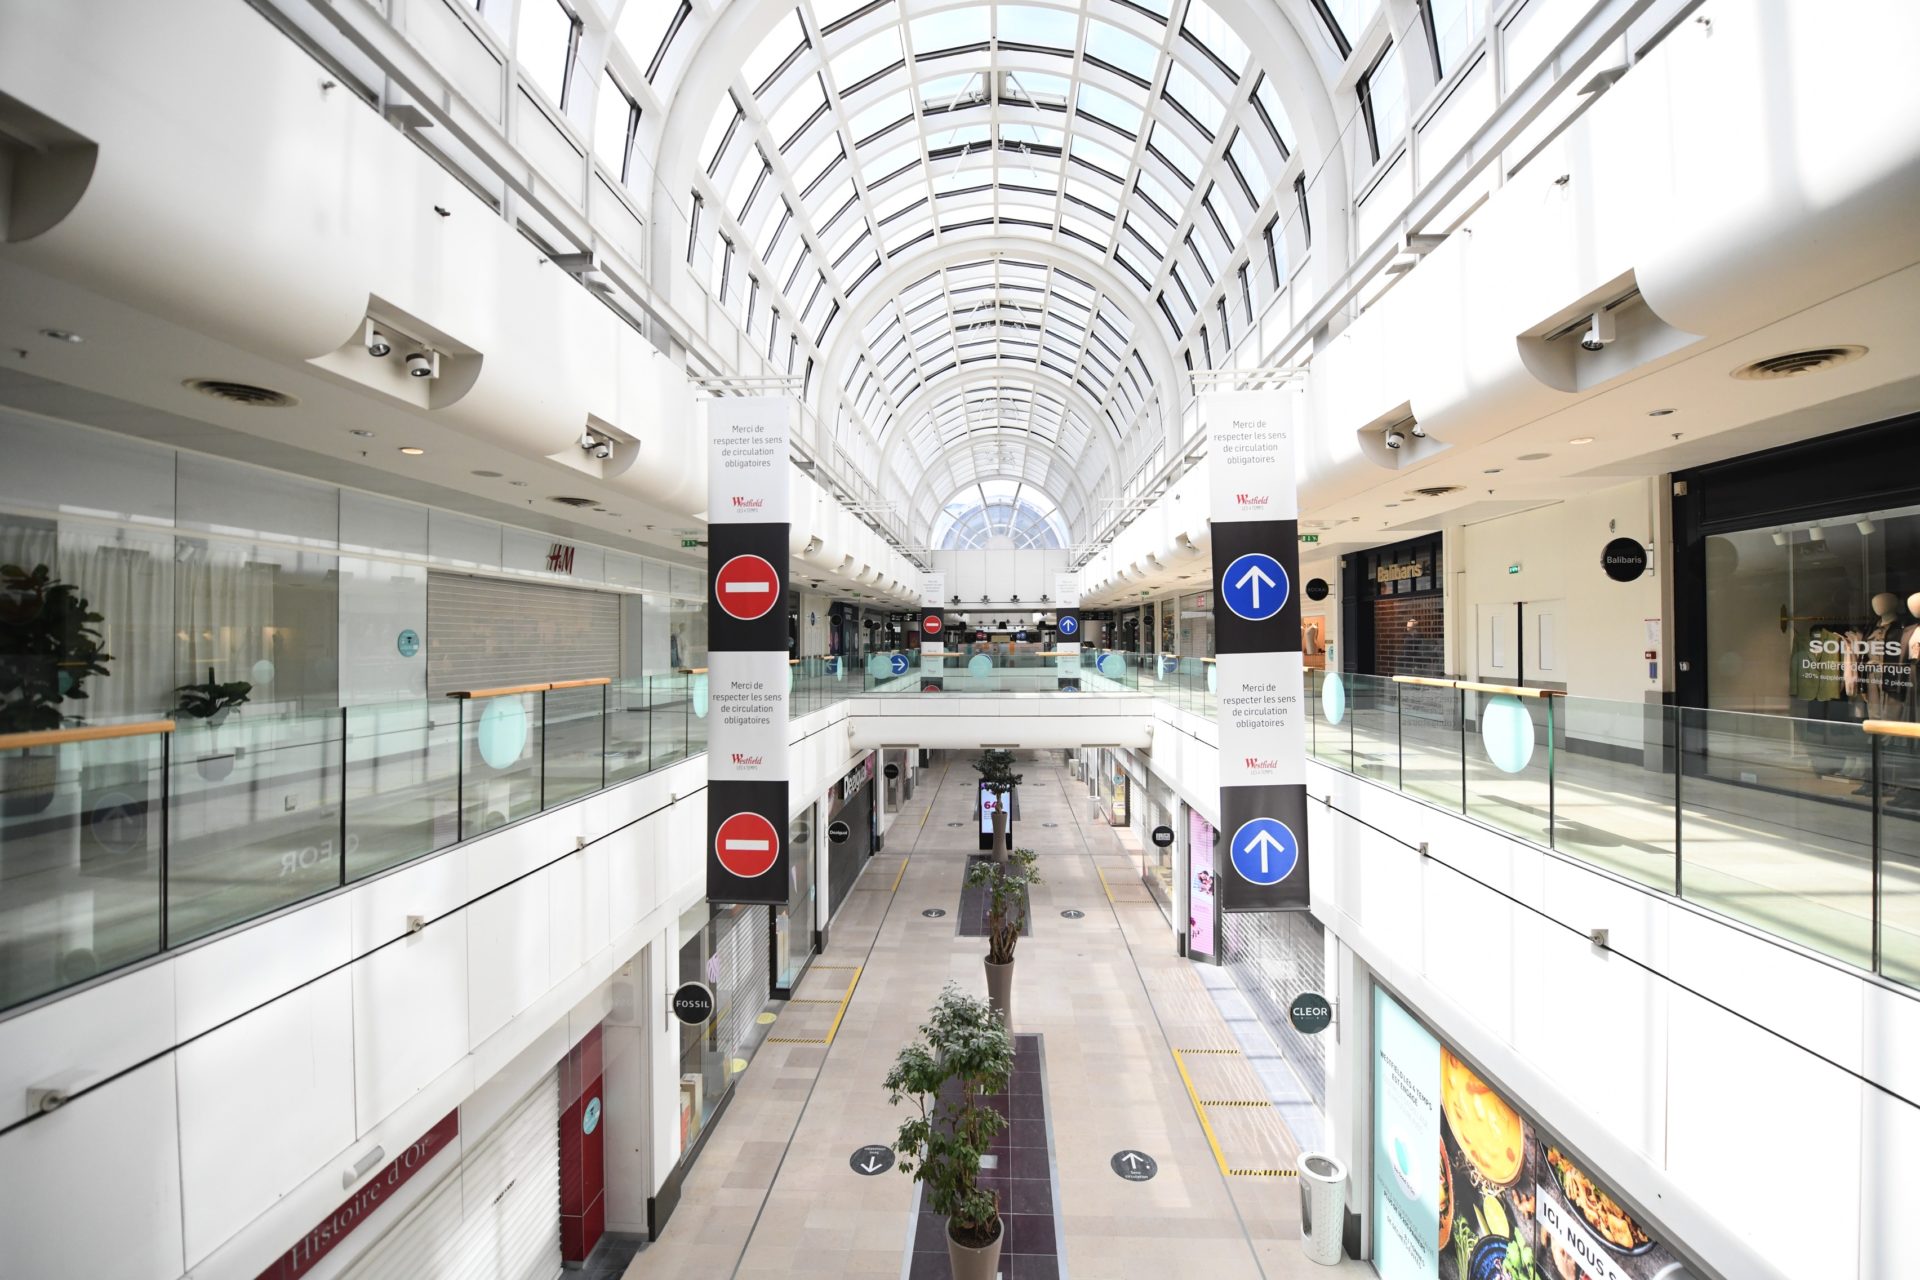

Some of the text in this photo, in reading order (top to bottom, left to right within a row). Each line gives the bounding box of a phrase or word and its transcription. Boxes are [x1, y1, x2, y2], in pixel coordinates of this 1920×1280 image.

[1233, 420, 1266, 428] Merci de
[714, 437, 750, 446] respecter
[1214, 433, 1252, 442] respecter
[1254, 432, 1266, 440] les
[722, 448, 774, 456] de circulation
[1235, 444, 1278, 452] circulation
[725, 460, 771, 469] obligatoires
[1227, 456, 1275, 465] obligatoires
[732, 496, 763, 507] Westfield
[1236, 494, 1269, 504] Westfield
[547, 544, 575, 575] H&M
[1606, 556, 1642, 564] Balibaris
[1377, 564, 1422, 582] Balibaris
[1809, 640, 1901, 656] SOLDES
[1802, 660, 1911, 676] Dernière démarque
[731, 681, 763, 689] Merci de
[1242, 684, 1264, 692] Merci
[713, 694, 749, 702] respecter
[751, 693, 762, 701] les
[1223, 697, 1262, 705] respecter
[1232, 707, 1287, 716] de circulation
[724, 716, 770, 725] obligatoires
[1236, 720, 1284, 729] obligatoires
[732, 754, 762, 764] Westfield
[1245, 758, 1277, 768] Westfield
[676, 1000, 710, 1008] FOSSIL
[1293, 1008, 1327, 1016] CLEOR
[292, 1139, 430, 1271] Histoire d'Or
[1543, 1202, 1563, 1235] ICI,
[1567, 1231, 1604, 1276] NOUS
